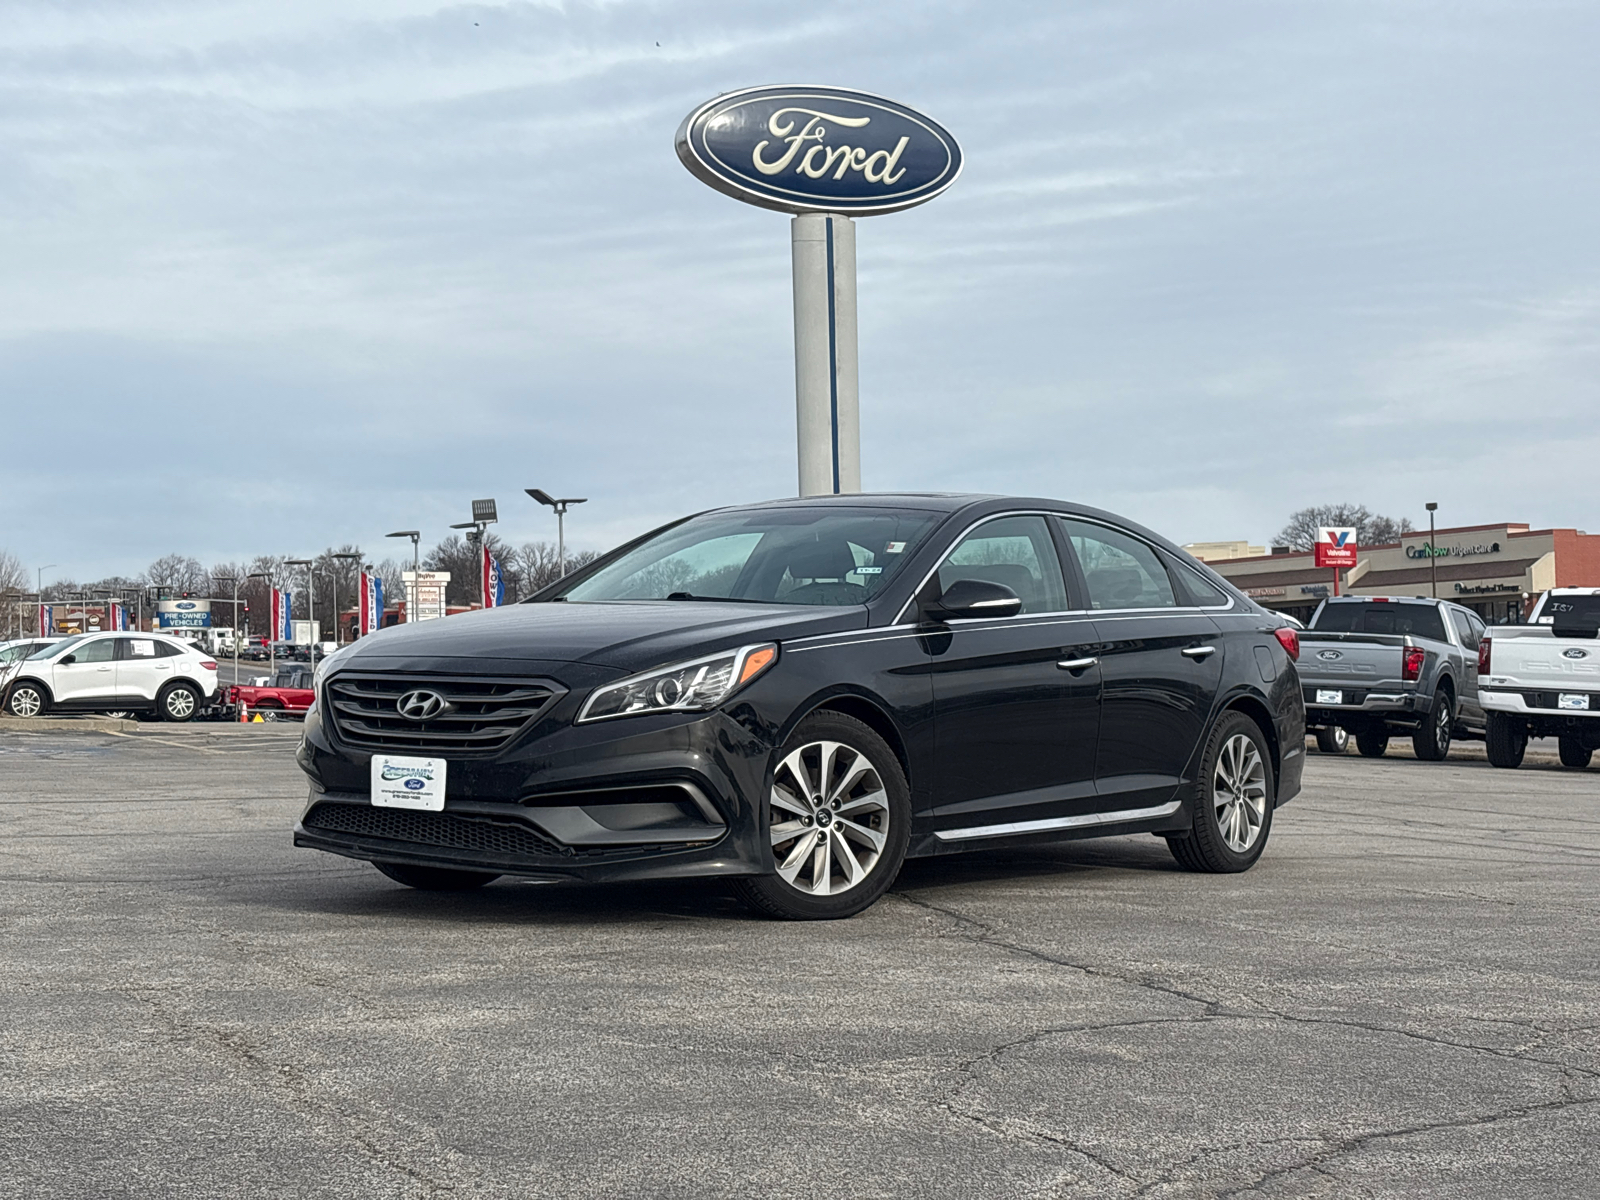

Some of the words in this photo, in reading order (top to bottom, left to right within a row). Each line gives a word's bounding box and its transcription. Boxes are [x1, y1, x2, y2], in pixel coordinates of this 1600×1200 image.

[753, 107, 909, 186] Ford
[1326, 549, 1351, 557] Valvoline
[1450, 545, 1474, 558] Urgent
[1475, 544, 1493, 554] Care
[164, 612, 208, 620] PRE-OWNED
[1519, 661, 1600, 674] F-15
